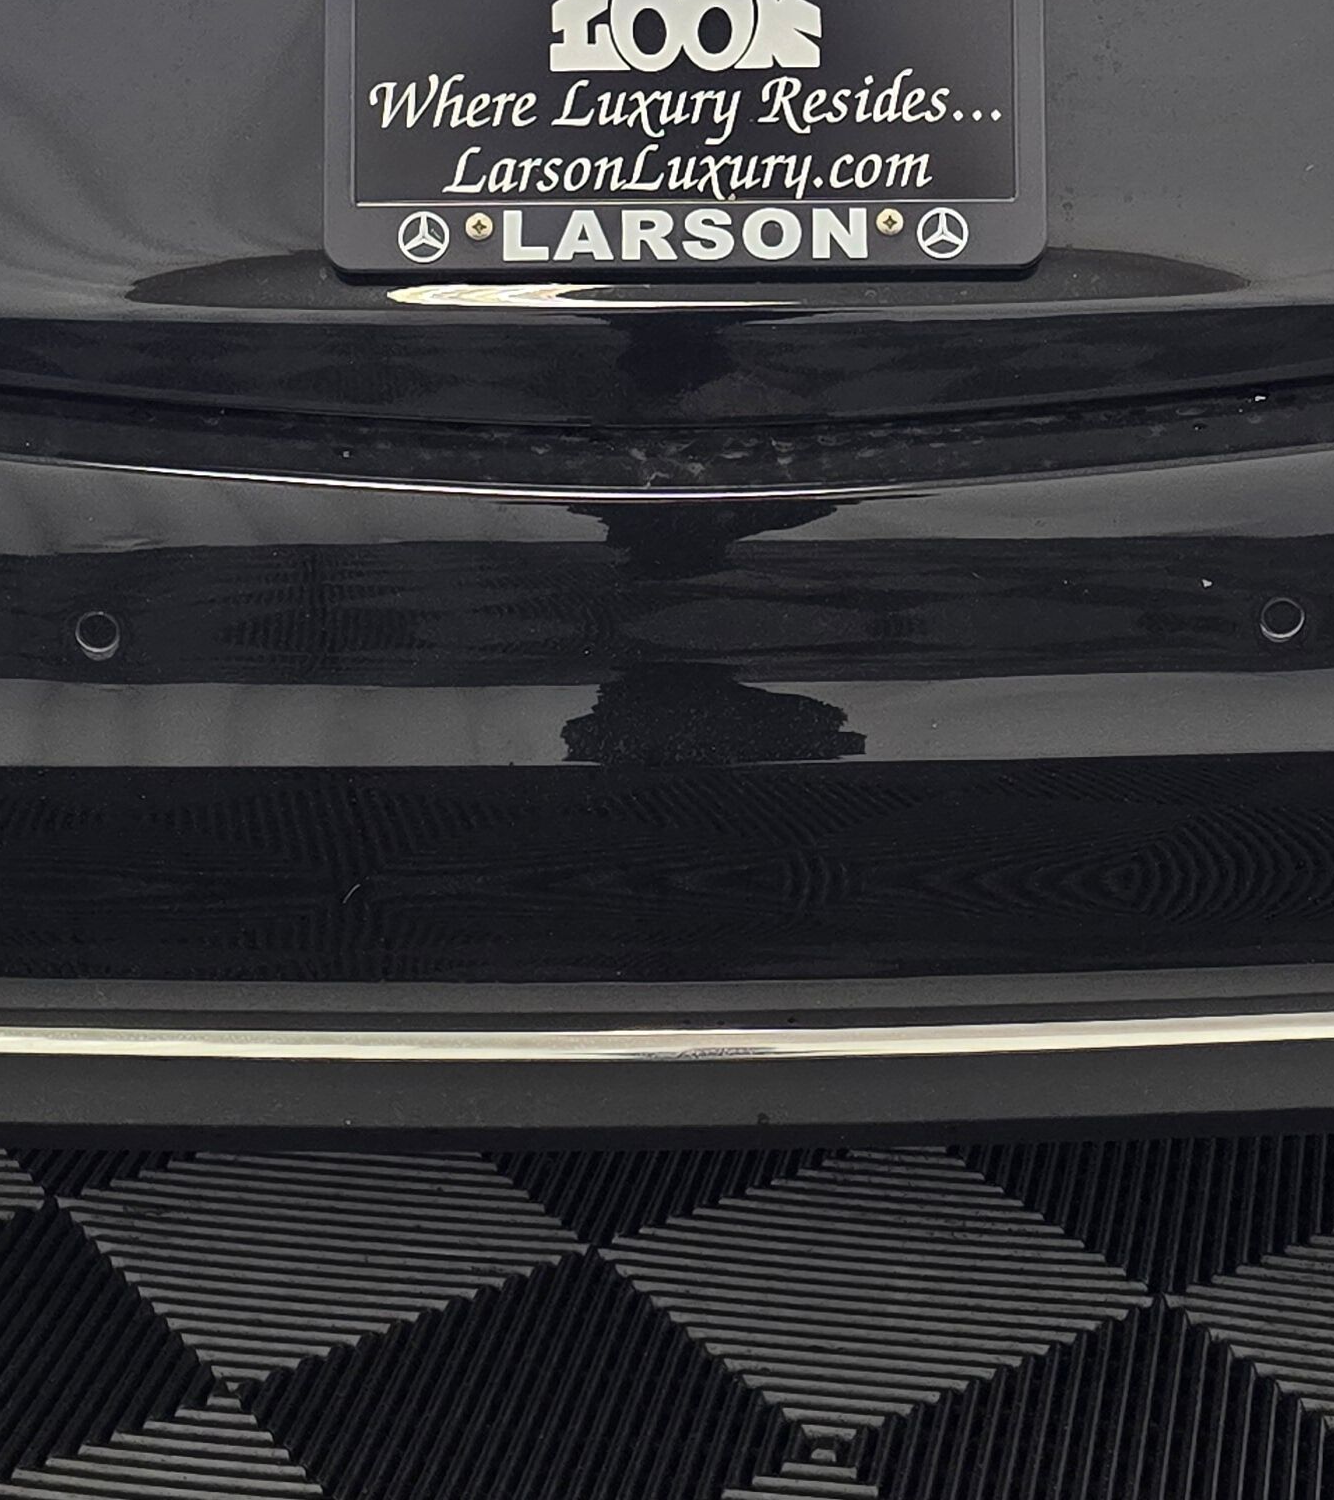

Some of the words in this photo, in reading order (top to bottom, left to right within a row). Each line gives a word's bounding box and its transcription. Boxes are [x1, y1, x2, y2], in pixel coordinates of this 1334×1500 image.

[369, 75, 538, 130] Where
[552, 79, 740, 145] Luxury
[758, 68, 1004, 134] Resides...
[442, 144, 933, 201] LarsonLuxury.com
[502, 207, 869, 262] LARSON
